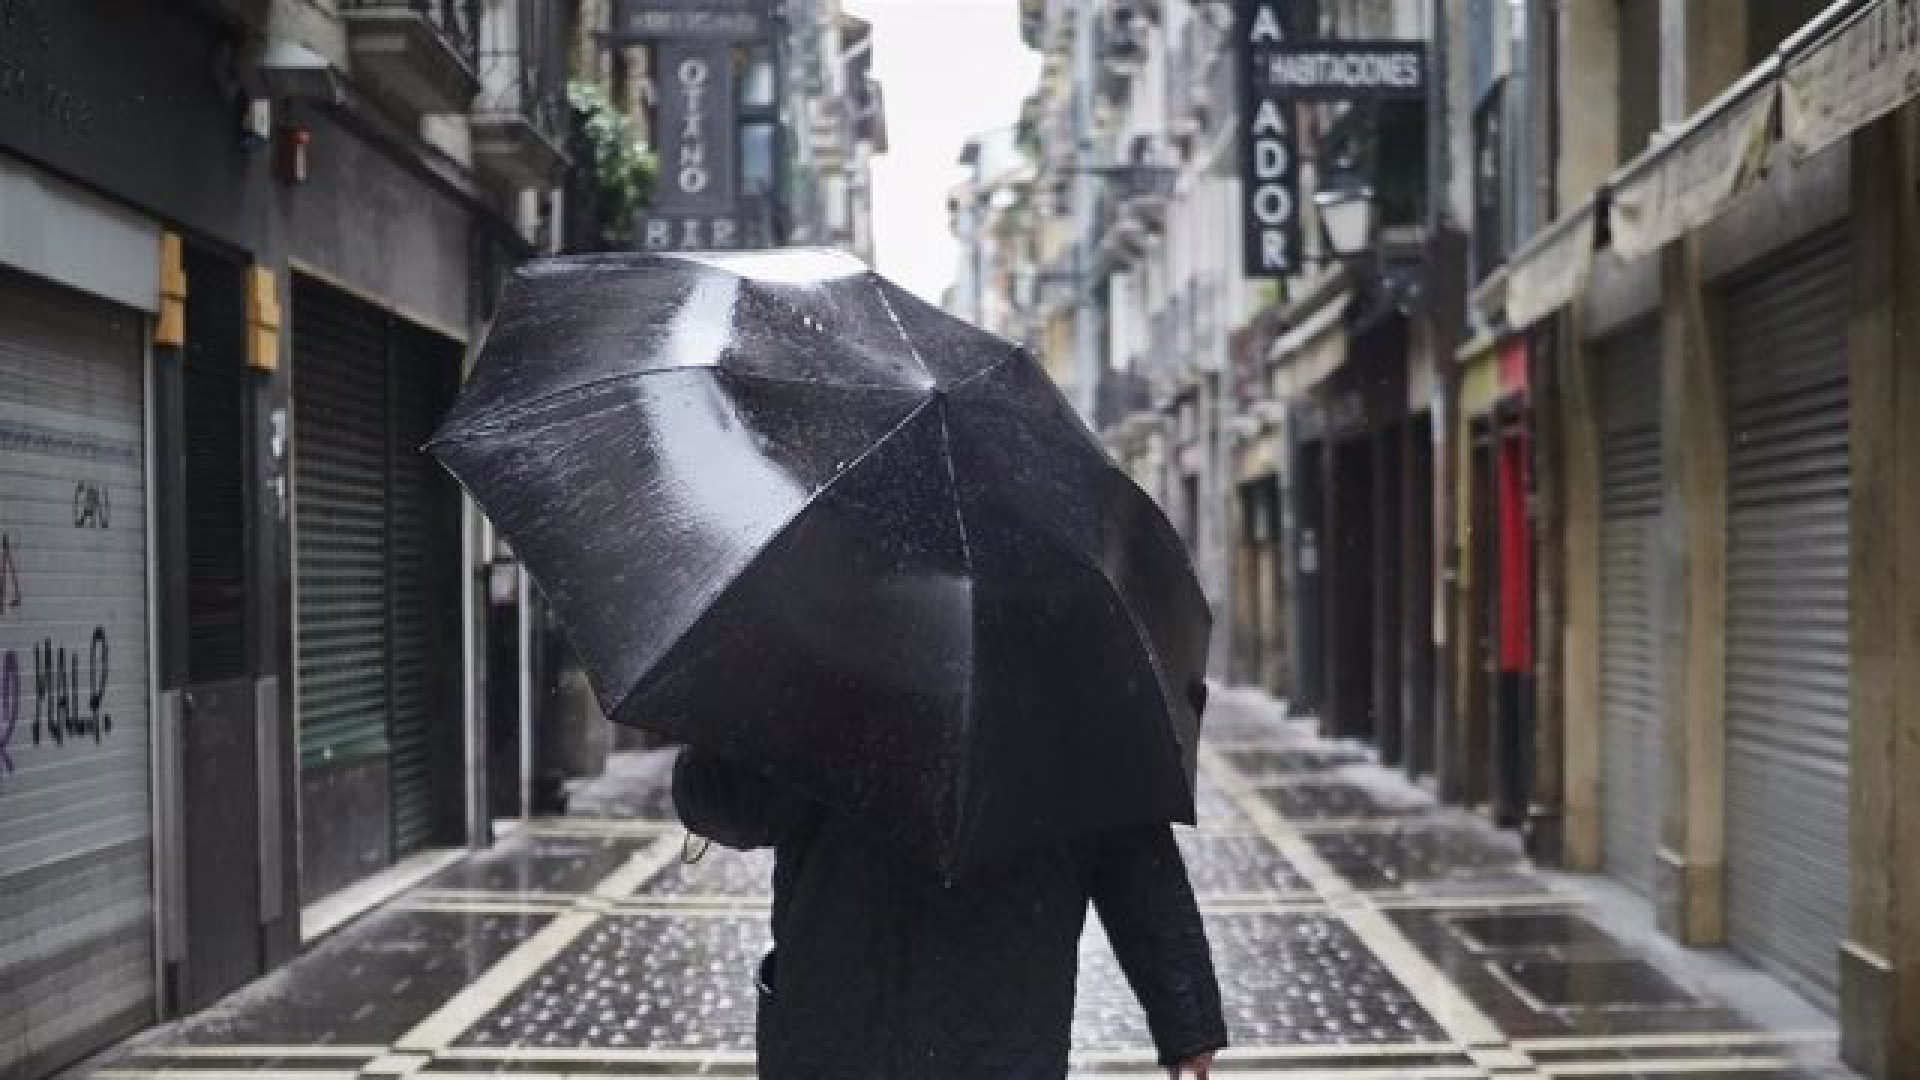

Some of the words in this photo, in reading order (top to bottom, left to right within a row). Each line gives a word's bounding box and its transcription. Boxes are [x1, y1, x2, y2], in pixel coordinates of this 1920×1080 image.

[677, 58, 708, 194] OTANO
[1268, 51, 1421, 87] HABITACIONES
[1250, 6, 1293, 270] AADOR
